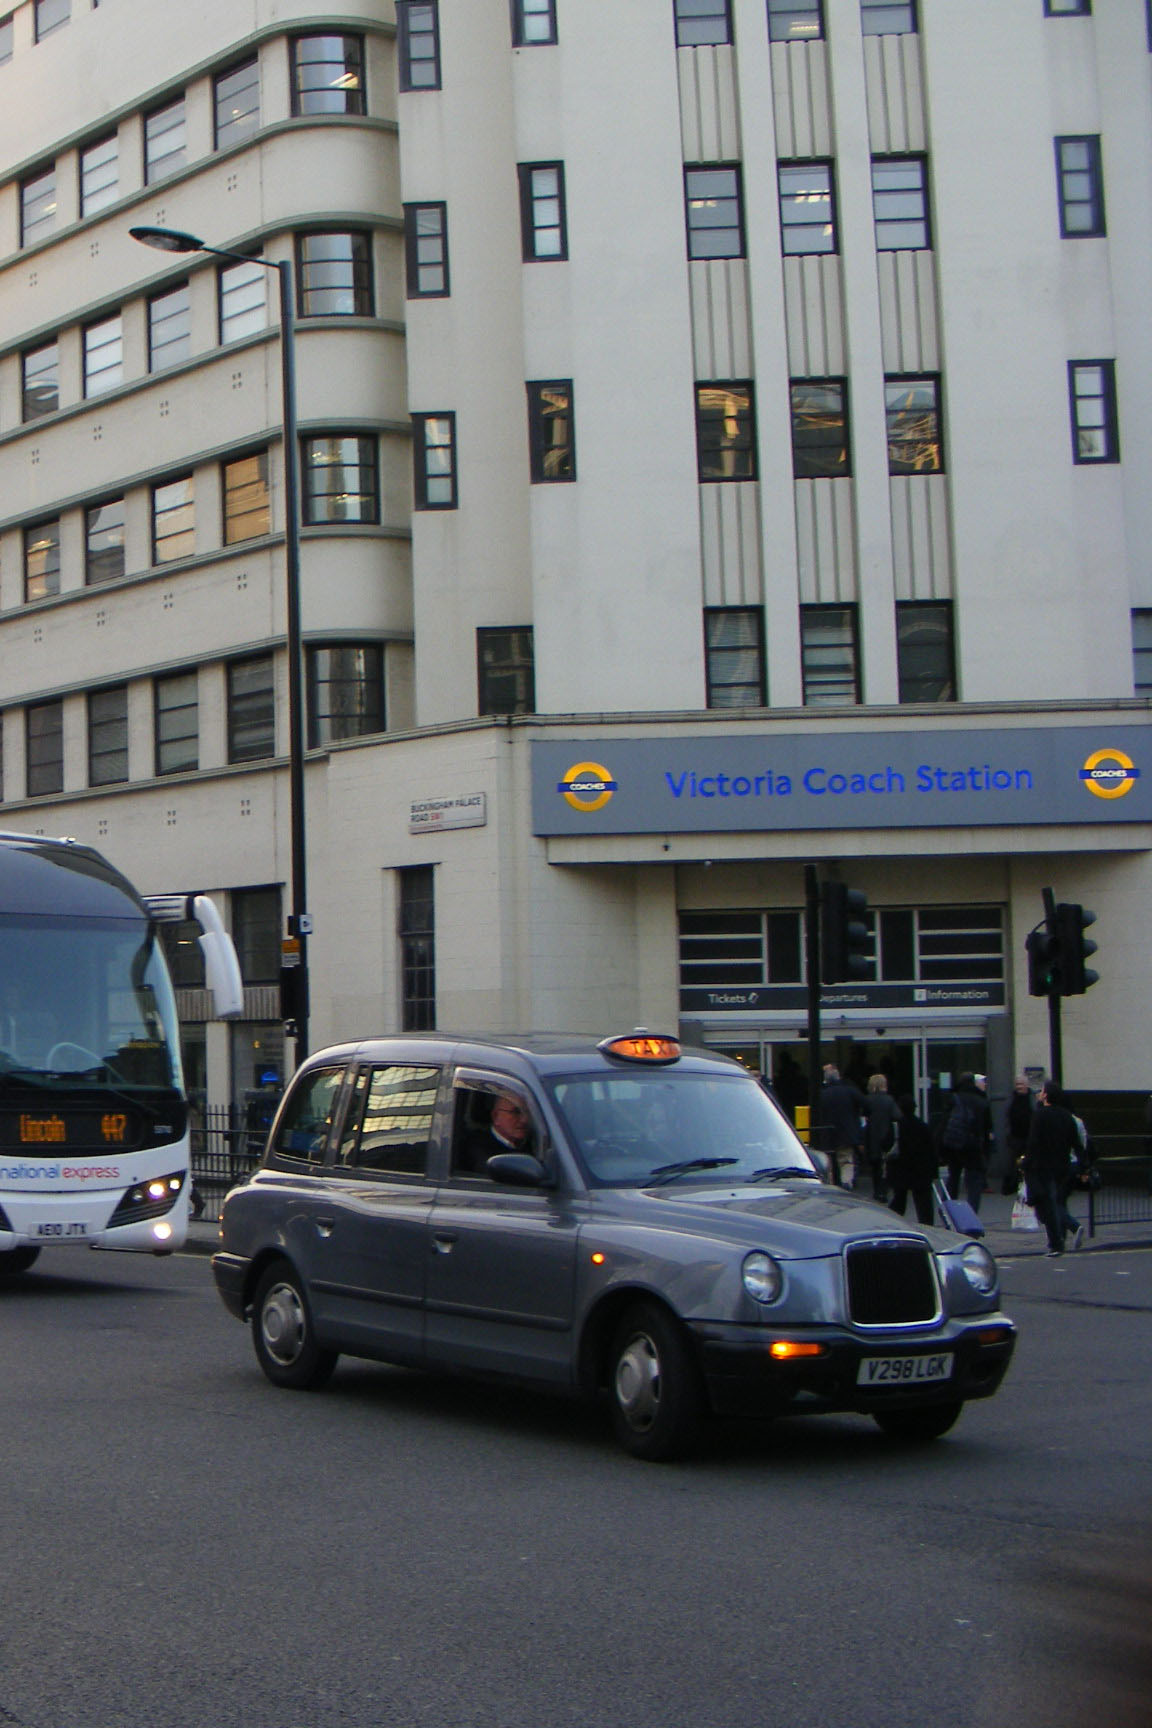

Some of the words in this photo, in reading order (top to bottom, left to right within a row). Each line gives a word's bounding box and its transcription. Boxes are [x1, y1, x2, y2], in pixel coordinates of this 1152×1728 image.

[1090, 769, 1128, 778] COACHES
[664, 769, 793, 799] Victoria
[802, 766, 906, 796] Coach
[915, 763, 1034, 793] Station
[569, 783, 606, 791] COACHES
[410, 812, 429, 823] ROAD
[708, 993, 747, 1004] Tickets
[927, 989, 989, 1000] Information
[61, 1166, 121, 1182] express
[915, 1356, 947, 1378] LGK
